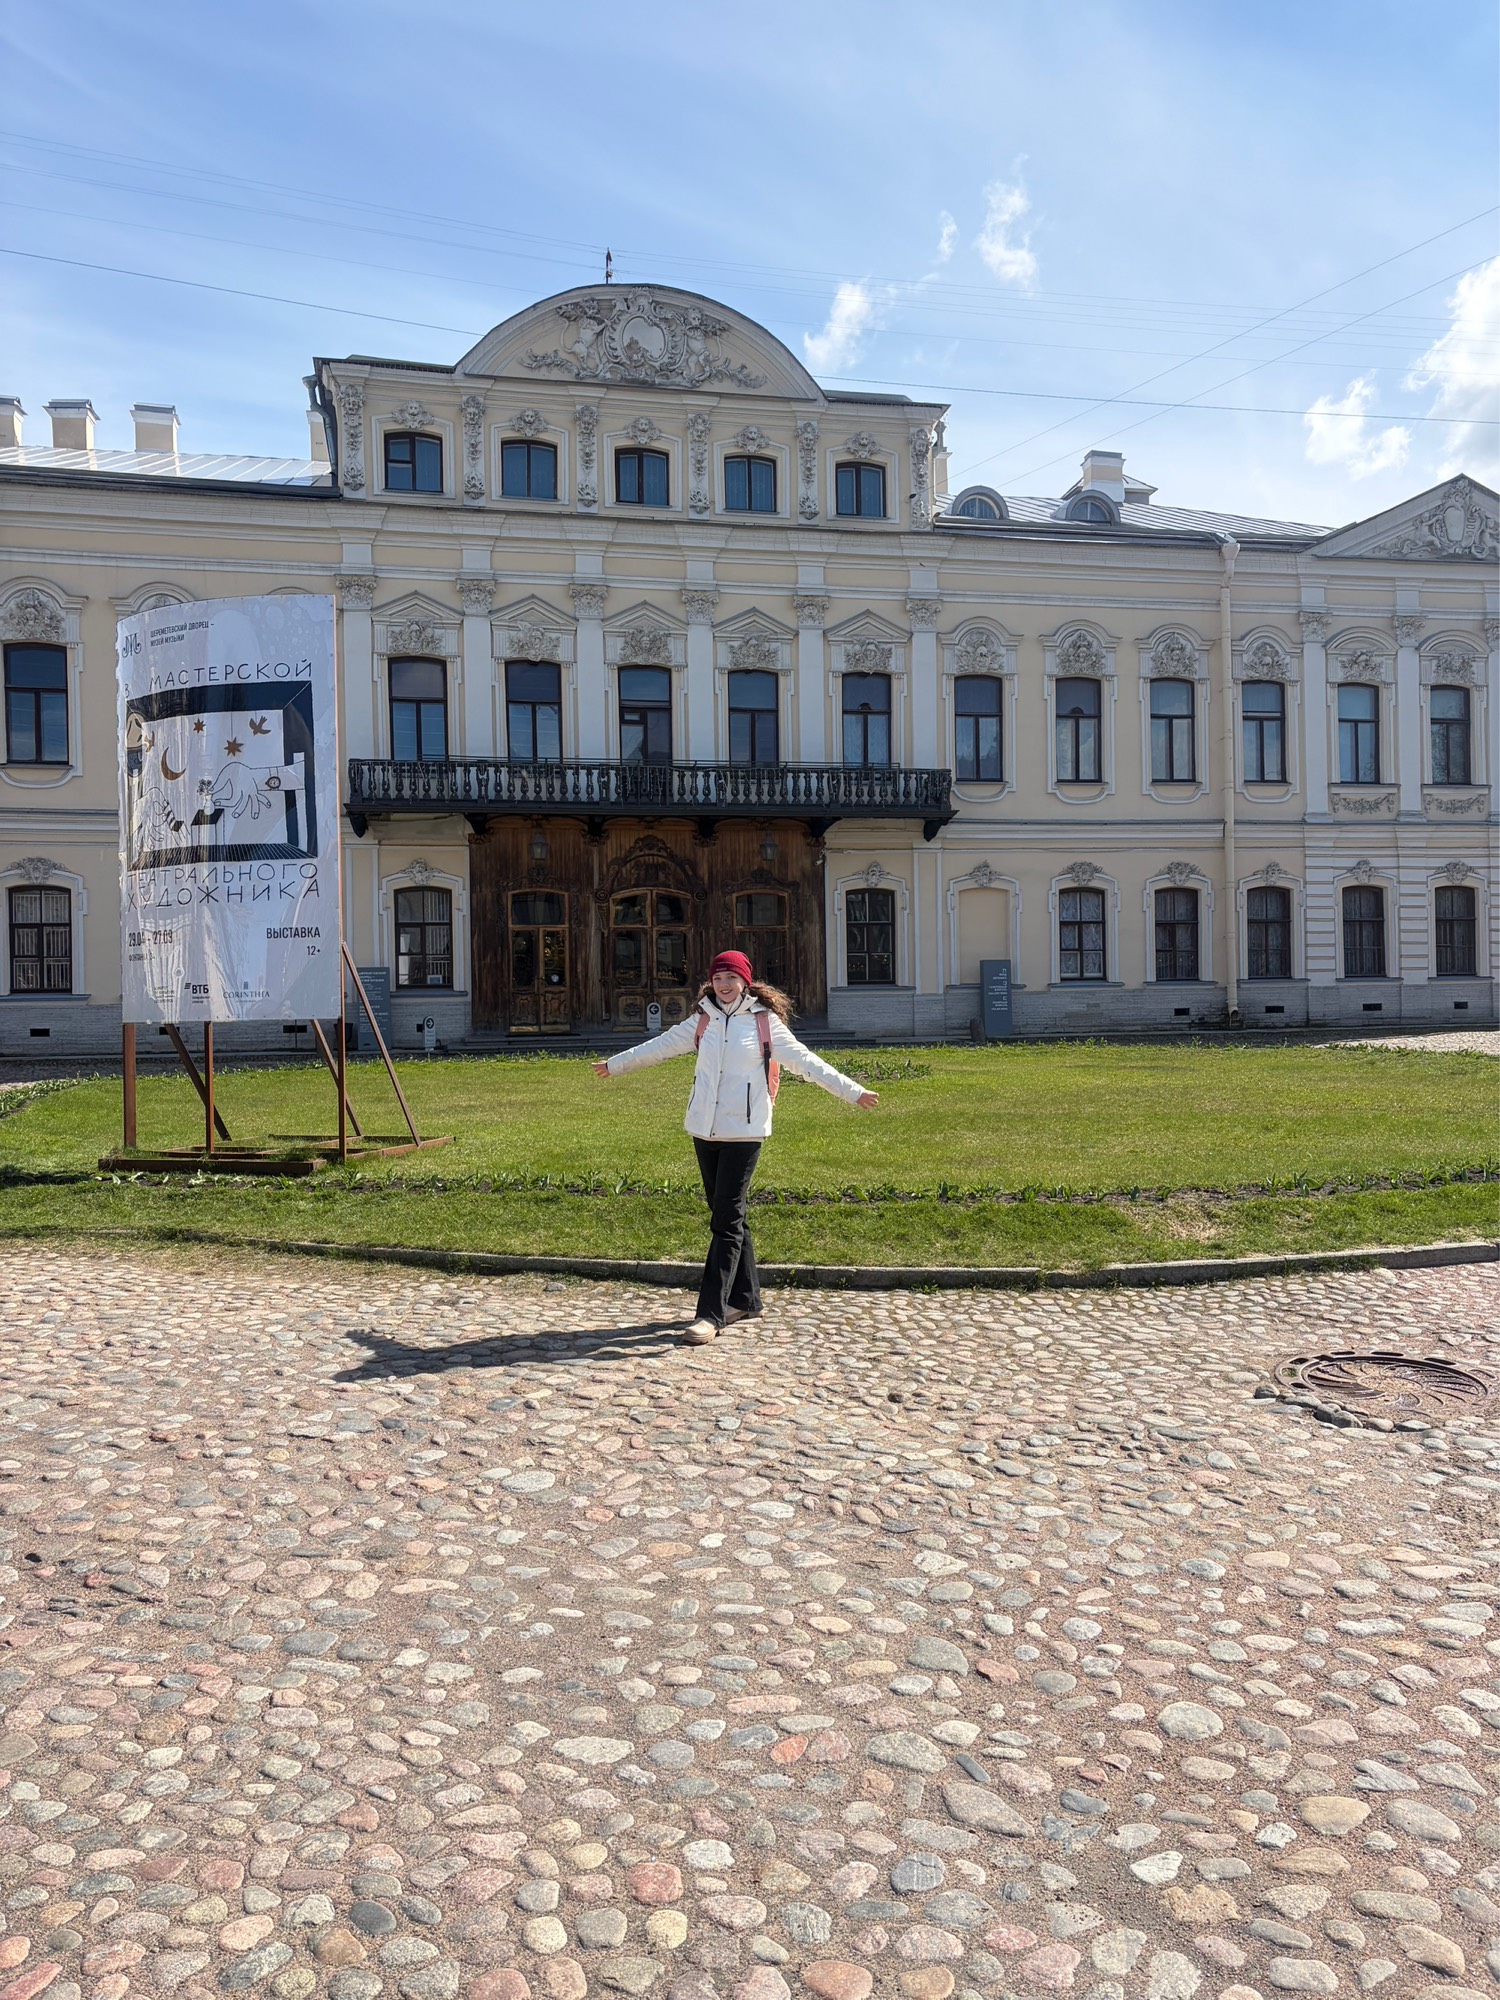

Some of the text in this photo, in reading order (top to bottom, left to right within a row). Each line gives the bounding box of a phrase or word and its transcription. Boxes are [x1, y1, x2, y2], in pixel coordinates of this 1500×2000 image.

[150, 622, 188, 638] ШЕРЕМЕТЕВСКИЙ
[188, 621, 209, 631] ДВОРЕЦ
[150, 634, 185, 647] МУЗЕЙ МУЗЫКИ
[148, 658, 313, 692] МАСТЕРСКОЙ
[127, 862, 318, 890] ТЕАТРАЛЬНОГО
[127, 878, 320, 913] ХУДОЖНИКА
[266, 926, 321, 939] ВЫСТАВКА
[306, 945, 321, 956] 12+
[191, 984, 209, 995] ВТБ
[222, 990, 270, 999] CORINTHIA
